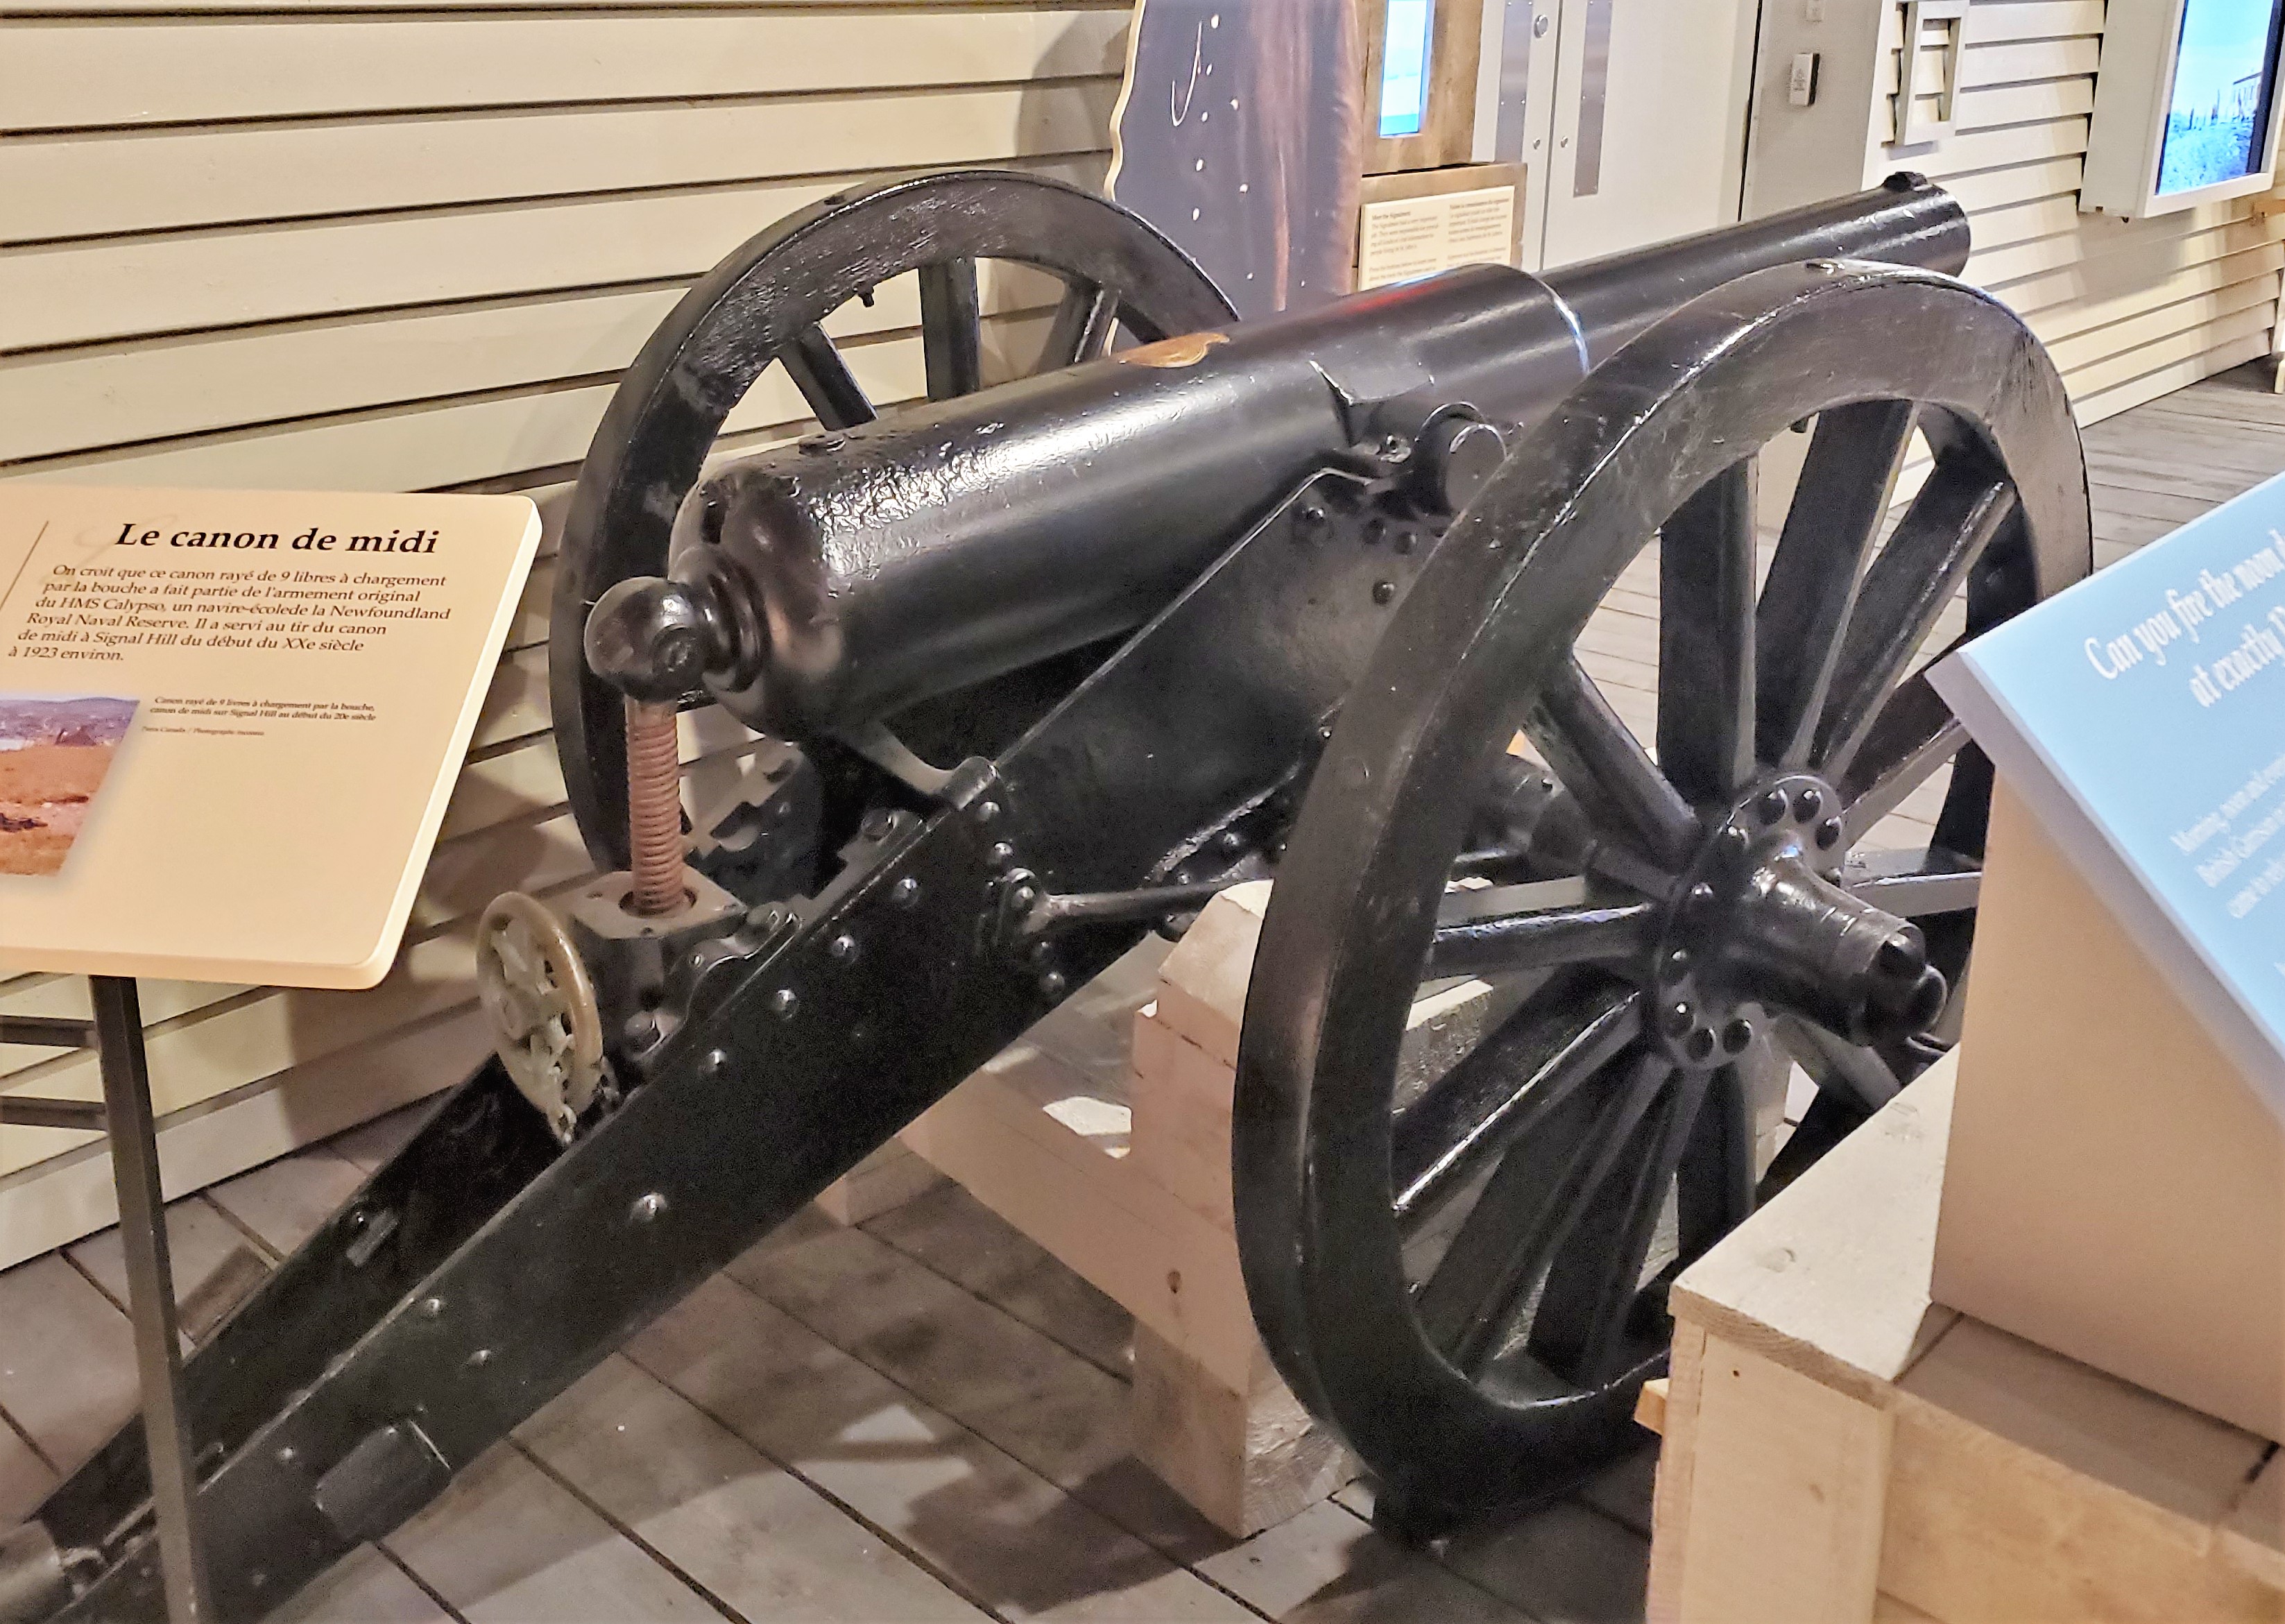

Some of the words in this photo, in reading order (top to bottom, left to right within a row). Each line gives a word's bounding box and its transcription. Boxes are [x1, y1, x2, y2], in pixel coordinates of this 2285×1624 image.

[114, 523, 160, 546] Le
[170, 531, 279, 549] canon
[291, 527, 337, 552] de
[345, 529, 440, 554] midi
[52, 565, 76, 576] On
[80, 567, 114, 578] croit
[117, 568, 146, 581] que
[149, 570, 166, 579] ce
[169, 570, 216, 581] canon
[219, 571, 255, 584] rayé
[257, 570, 277, 582] de
[281, 571, 291, 582] 9
[339, 572, 349, 583] à
[352, 572, 447, 588] chargement
[42, 583, 72, 595] par
[73, 581, 87, 592] la
[90, 581, 146, 595] bouche
[149, 586, 160, 595] a
[162, 583, 189, 597] fait
[191, 585, 239, 599] partie
[241, 586, 262, 598] de
[357, 590, 421, 604] original
[35, 596, 57, 608] du
[59, 598, 101, 609] HMS
[172, 603, 193, 613] un
[311, 604, 326, 616] la
[330, 605, 452, 619] Newfoundland
[26, 613, 73, 628] Royal
[75, 613, 121, 628] Naval
[126, 615, 190, 629] Reserve.
[194, 618, 208, 630] Il
[209, 621, 219, 631] a
[222, 620, 262, 631] servi
[265, 622, 286, 633] au
[289, 622, 310, 633] tir
[312, 622, 335, 633] du
[339, 624, 387, 635] canon
[2084, 634, 2144, 681] Can
[2132, 609, 2182, 667] you
[2164, 588, 2214, 645] fire
[2198, 568, 2243, 609] the
[17, 629, 39, 641] de
[40, 630, 78, 642] midi
[80, 631, 90, 642] à
[94, 631, 144, 647] Signal
[146, 633, 178, 646] Hill
[180, 634, 203, 647] du
[205, 635, 253, 649] début
[256, 637, 278, 649] du
[282, 638, 316, 650] XXe
[318, 638, 365, 651] siècle
[8, 646, 18, 658] à
[22, 647, 58, 659] 1923
[60, 649, 125, 661] environ.
